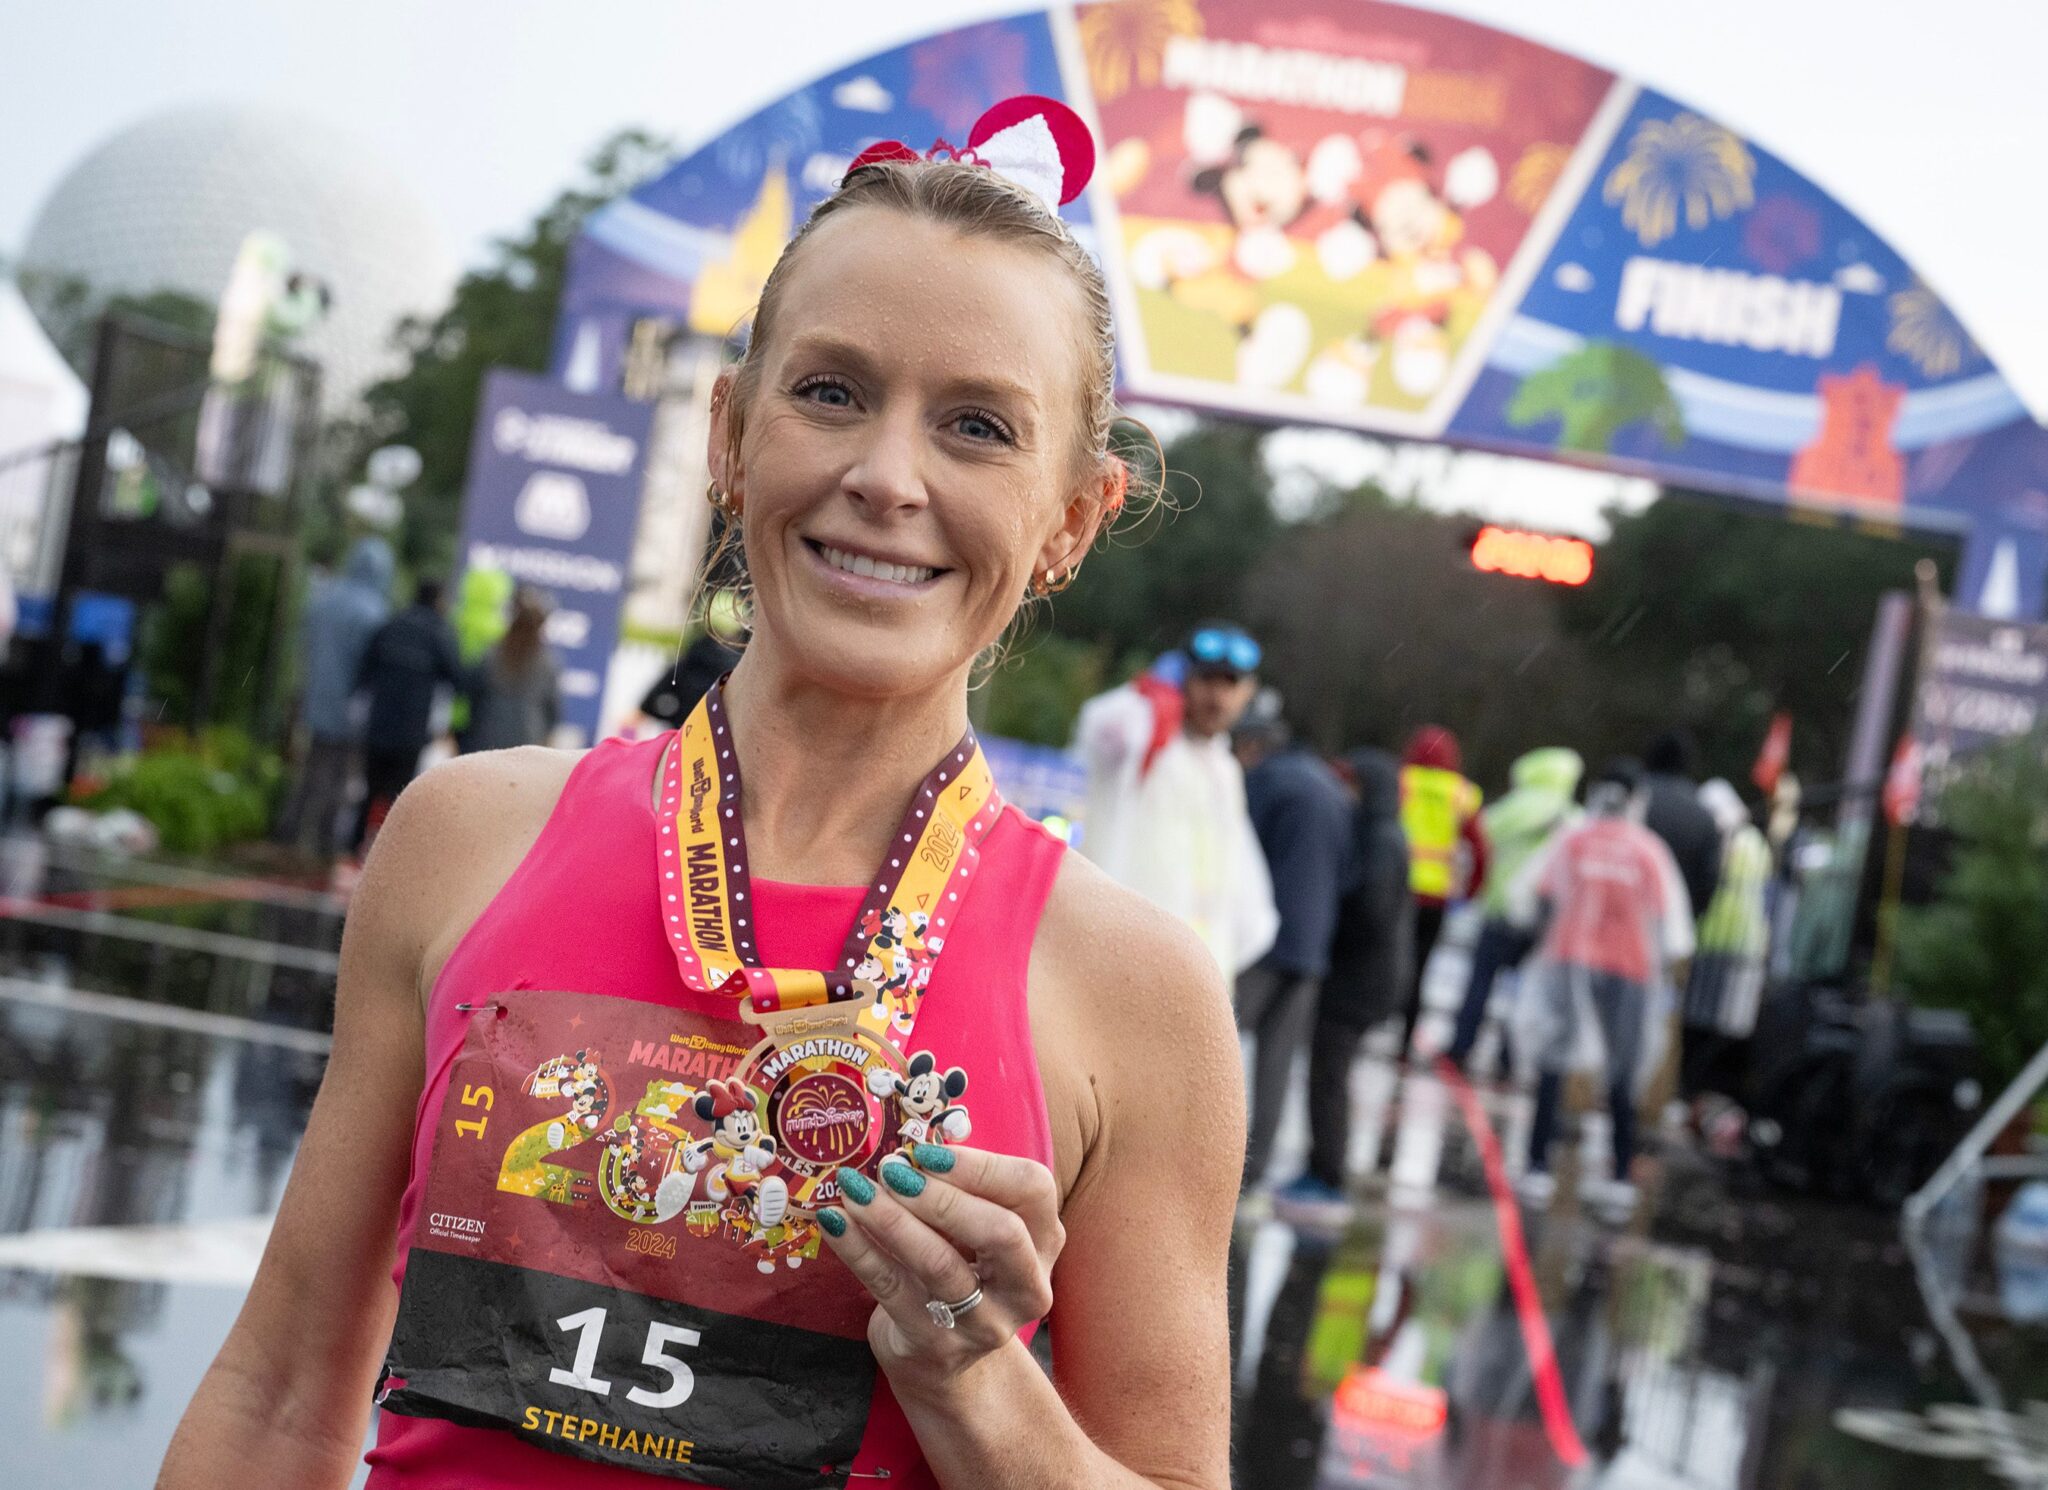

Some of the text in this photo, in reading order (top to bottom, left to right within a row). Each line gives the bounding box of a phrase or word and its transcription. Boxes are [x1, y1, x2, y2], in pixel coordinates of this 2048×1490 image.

[1615, 256, 1843, 358] FINISH
[686, 842, 729, 953] MARATHON
[626, 1040, 757, 1082] MARATH
[670, 1033, 690, 1045] Walt
[688, 1034, 726, 1053] Disney
[762, 1038, 871, 1080] MARATHON
[455, 1083, 495, 1141] 15
[693, 1202, 718, 1212] FINISH
[816, 1181, 842, 1200] 202
[429, 1227, 481, 1244] Official Timekeeper
[430, 1212, 486, 1235] CITIZEN
[624, 1228, 677, 1260] 2024
[548, 1306, 701, 1408] 15
[521, 1406, 695, 1465] STEPHANIE
